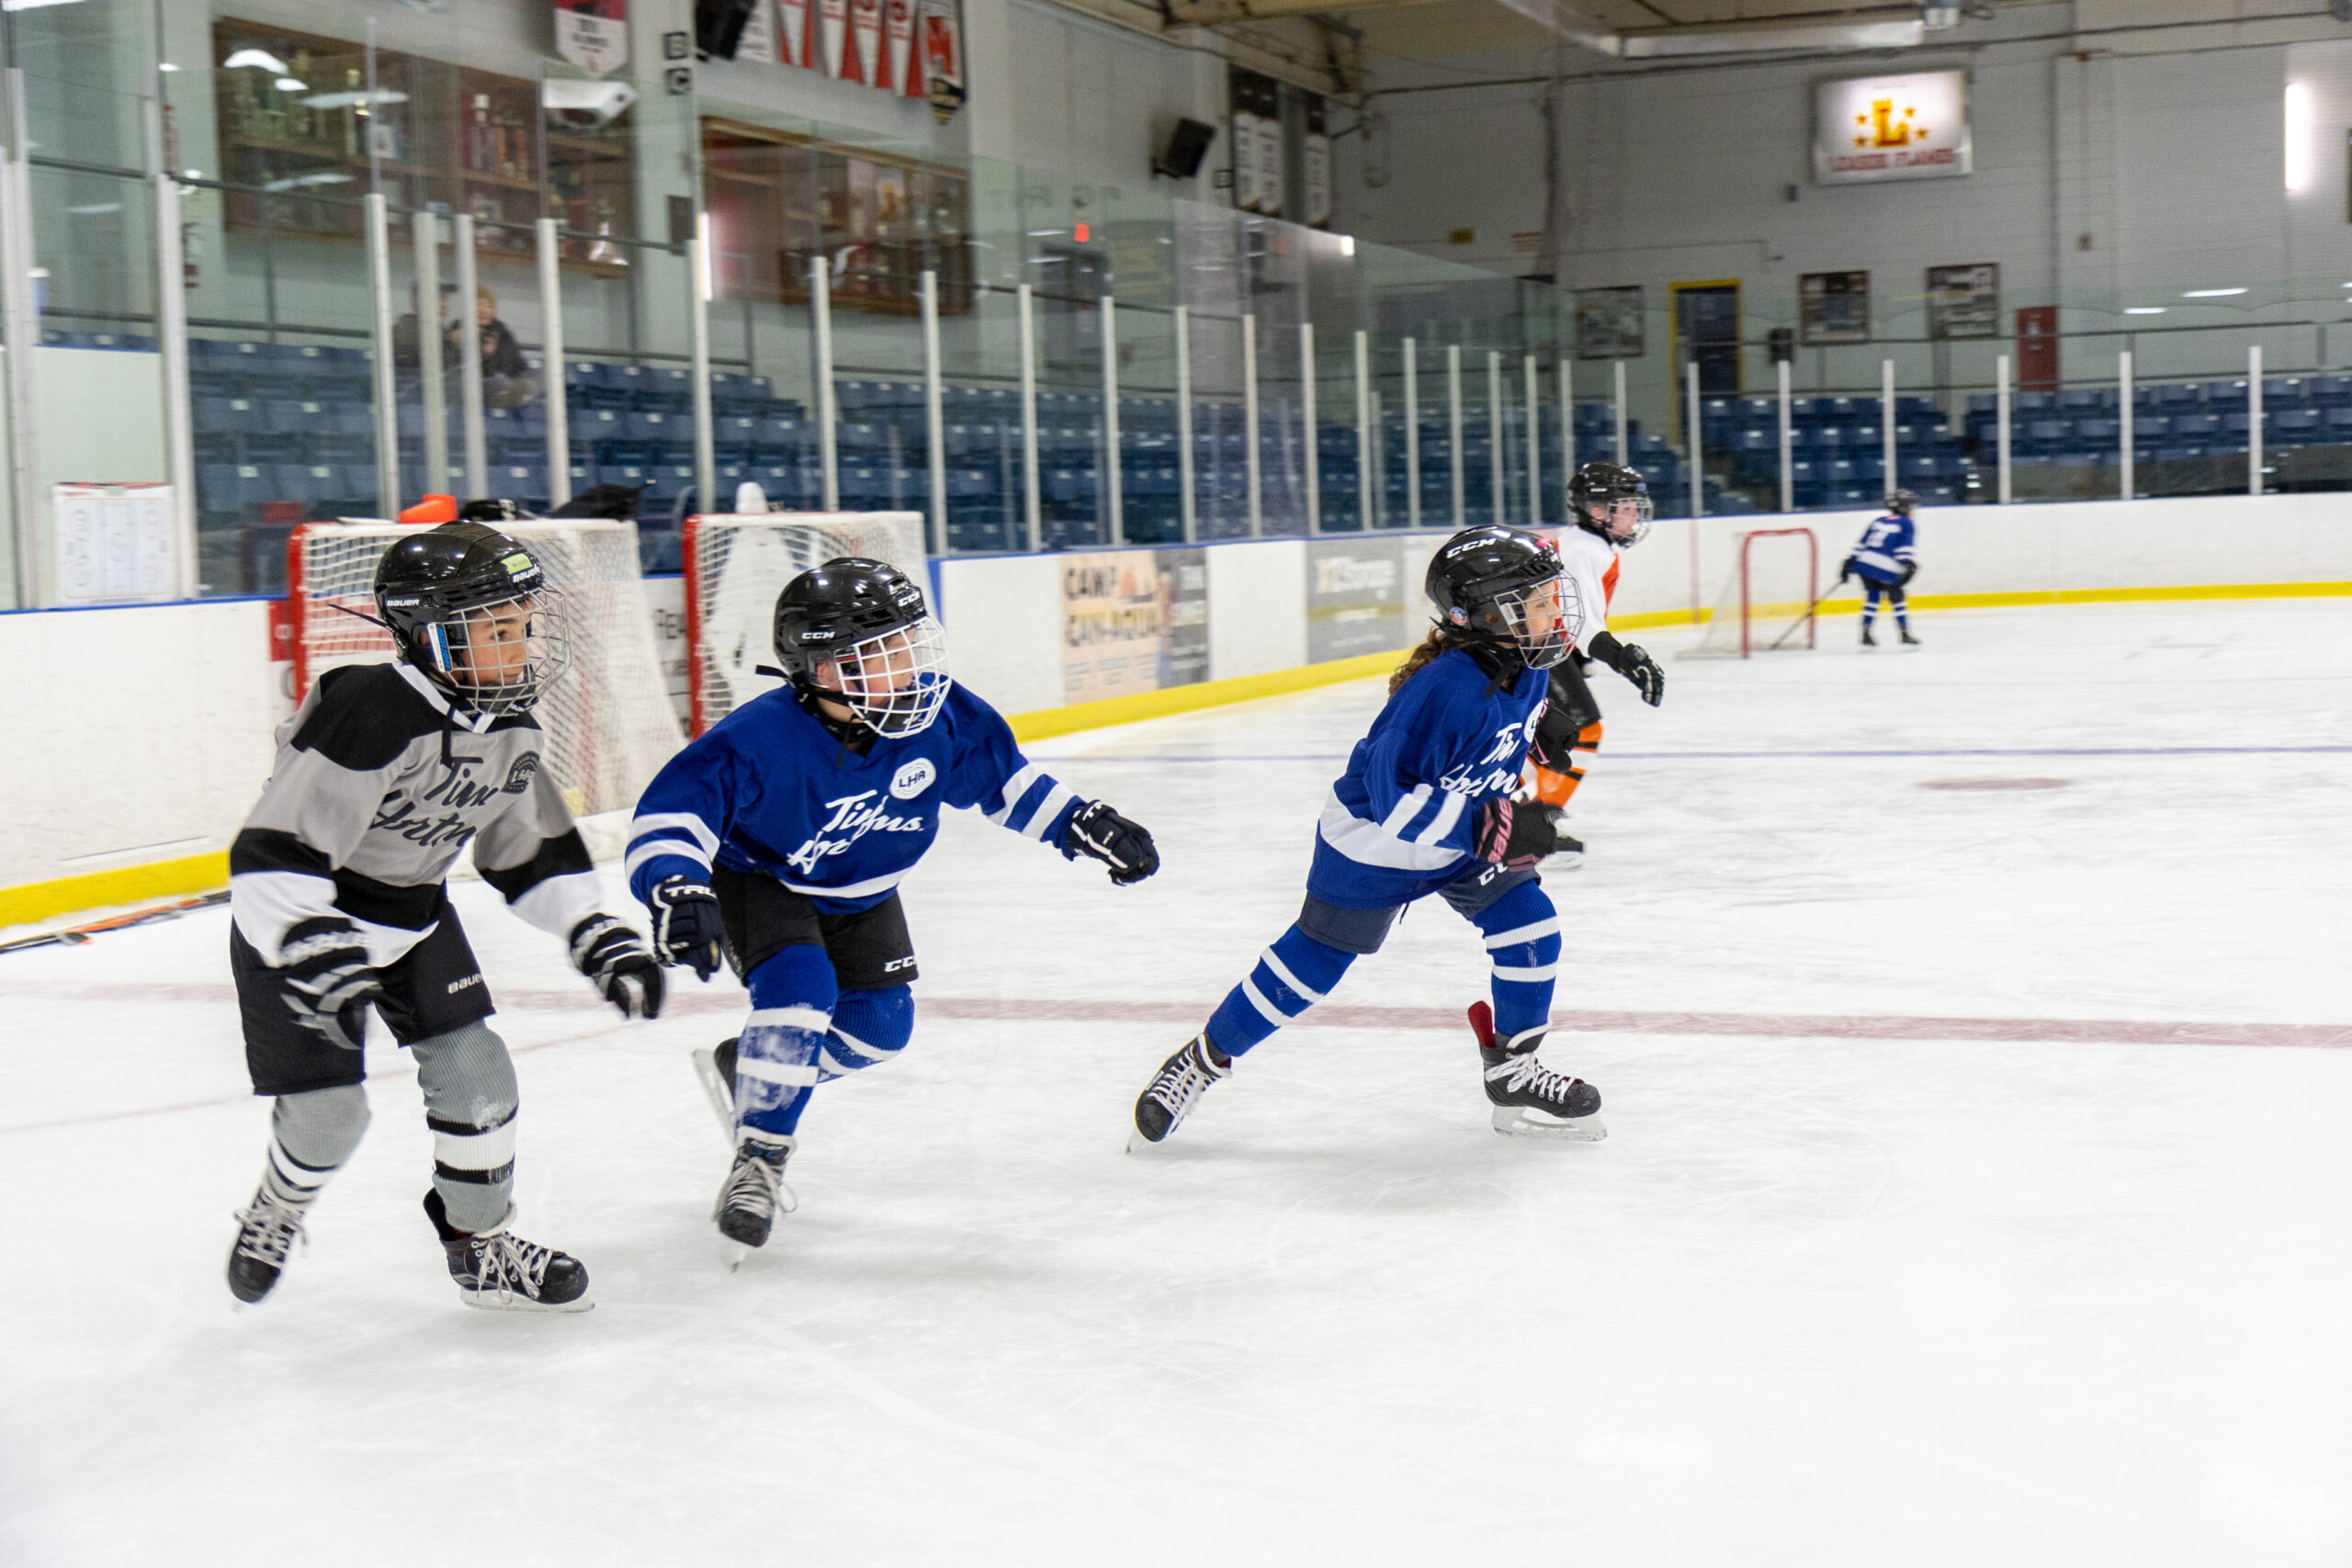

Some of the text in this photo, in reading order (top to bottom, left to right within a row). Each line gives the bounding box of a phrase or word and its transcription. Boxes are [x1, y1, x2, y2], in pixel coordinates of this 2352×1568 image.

[1446, 537, 1497, 558] CCM
[801, 631, 836, 640] CCM
[899, 770, 926, 788] LHA
[884, 955, 916, 973] CC
